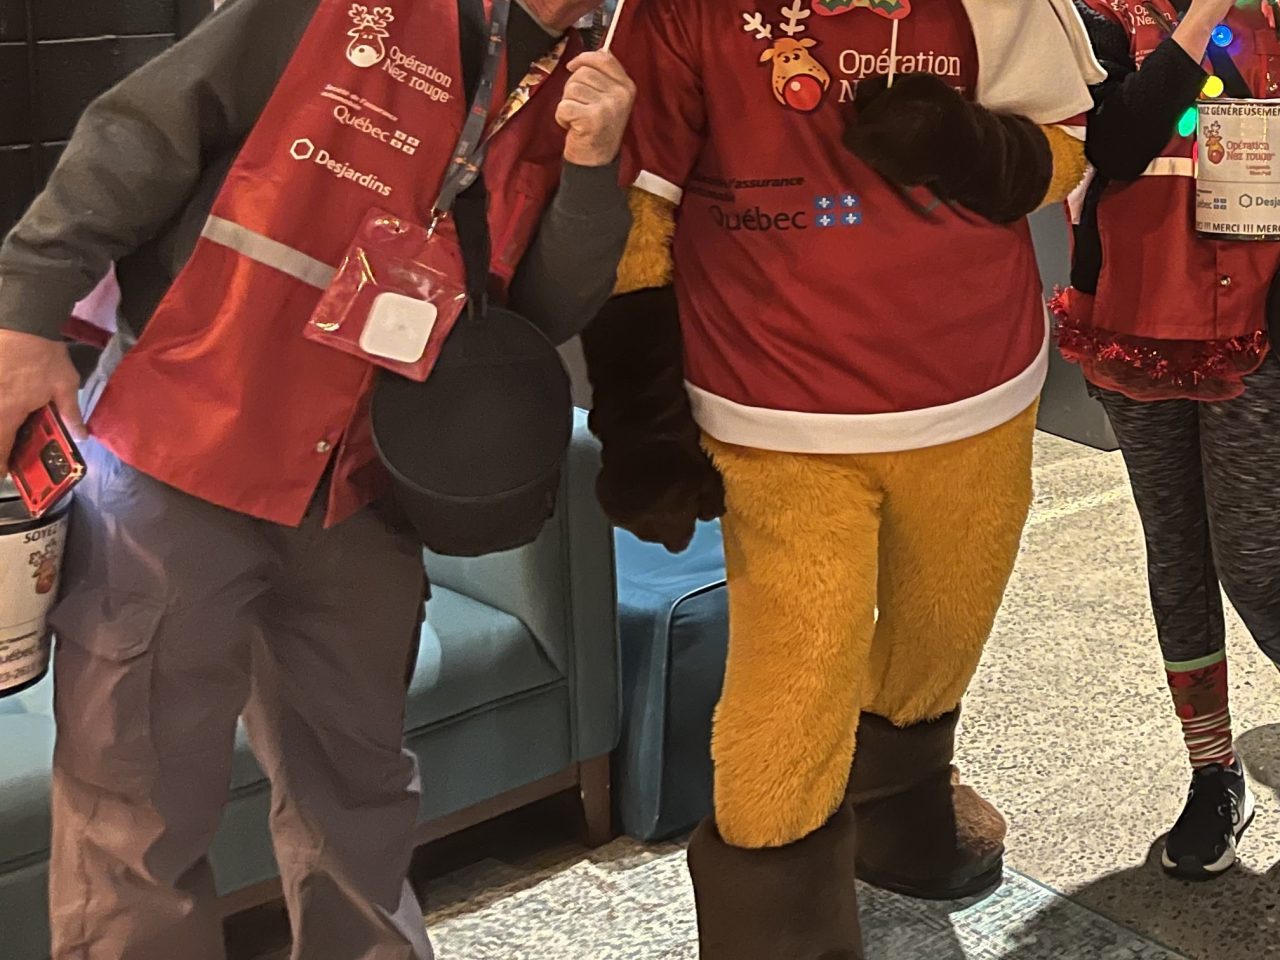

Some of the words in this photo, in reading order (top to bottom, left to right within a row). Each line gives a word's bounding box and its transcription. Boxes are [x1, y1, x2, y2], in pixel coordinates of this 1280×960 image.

[382, 60, 406, 83] Nez
[409, 76, 450, 103] rouge
[389, 45, 452, 88] Opération
[838, 48, 961, 78] Opération
[333, 105, 390, 142] Québec
[315, 150, 392, 196] Desjardins
[1213, 223, 1240, 232] MERCI
[23, 526, 57, 543] SOYEZ
